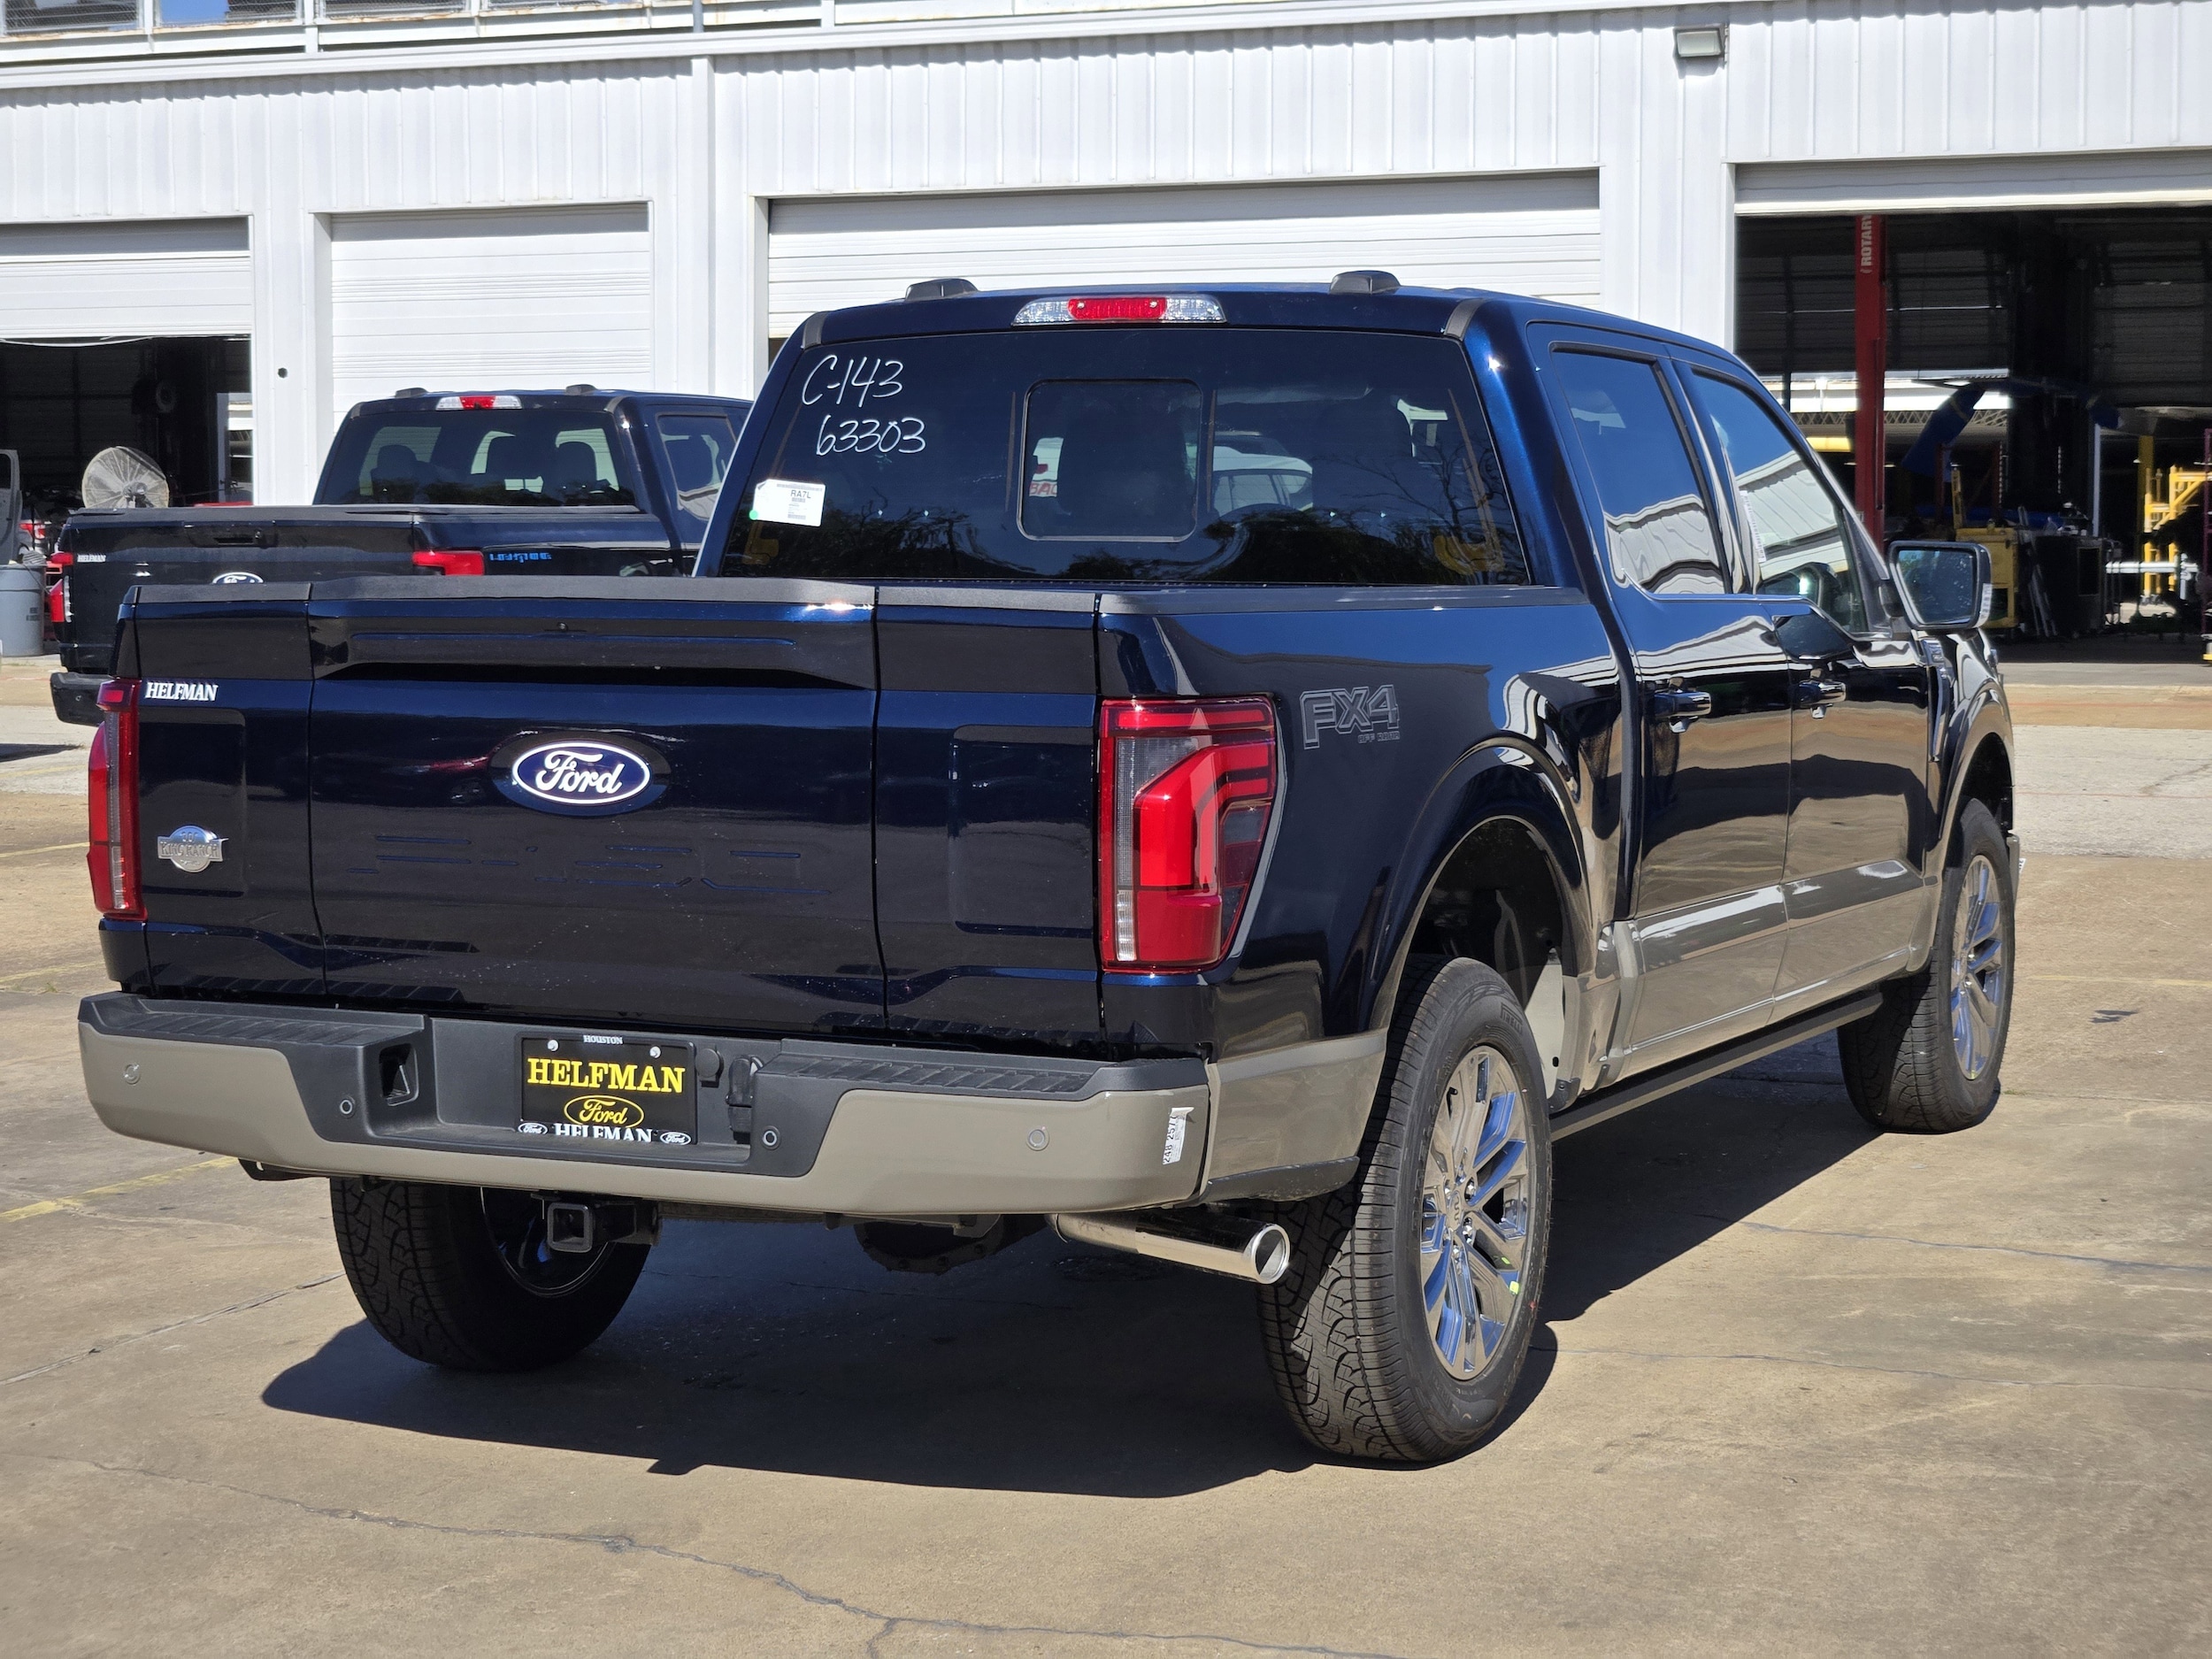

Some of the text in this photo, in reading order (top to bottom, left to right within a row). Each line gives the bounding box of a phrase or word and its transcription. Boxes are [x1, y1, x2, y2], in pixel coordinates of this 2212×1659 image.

[802, 354, 903, 408] C-143
[816, 414, 926, 457] 63303
[790, 489, 811, 499] RA7L
[144, 681, 219, 702] HELFMAN
[1299, 684, 1400, 750] FX4
[534, 749, 626, 795] Ford
[583, 1034, 624, 1045] HOUSTON
[527, 1057, 686, 1094] HELFMAN
[579, 1097, 629, 1125] Ford
[553, 1123, 653, 1143] HELFMAN
